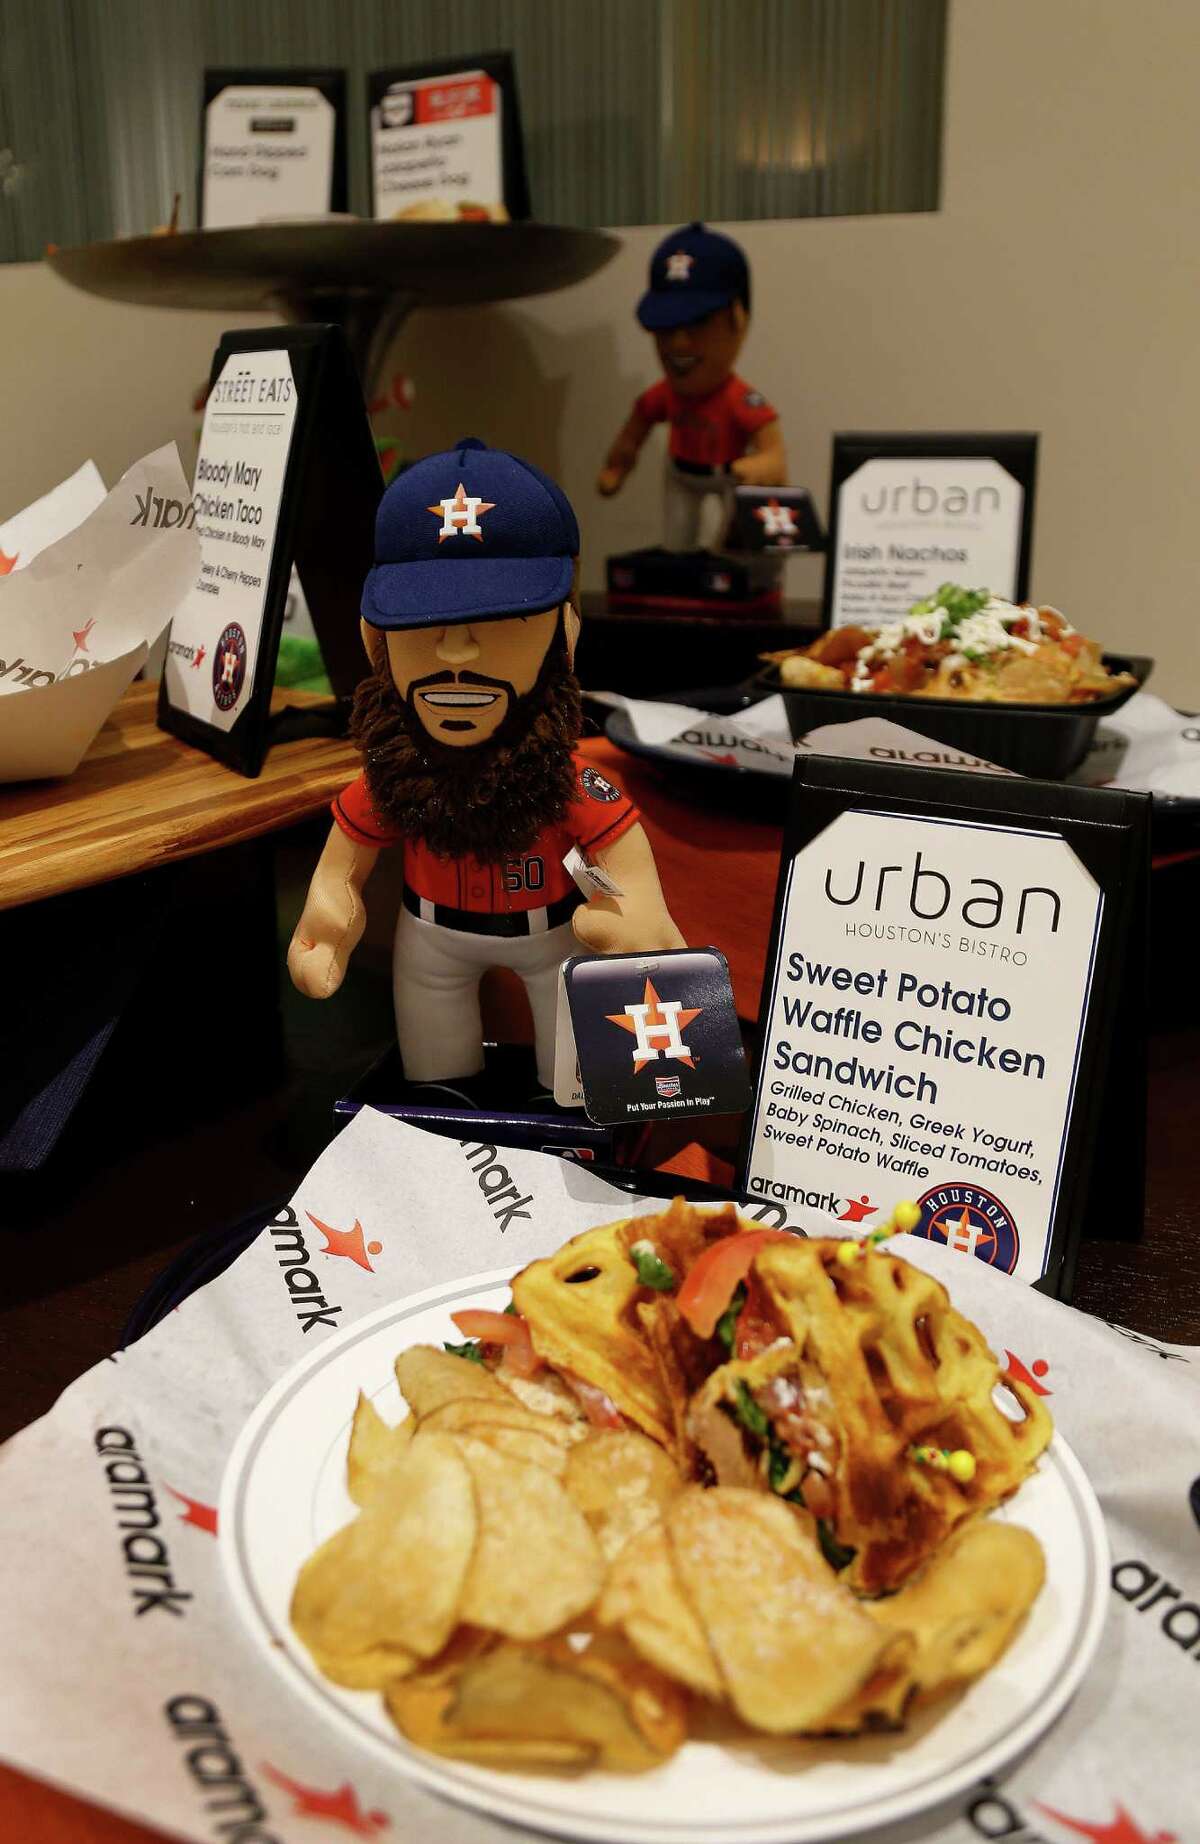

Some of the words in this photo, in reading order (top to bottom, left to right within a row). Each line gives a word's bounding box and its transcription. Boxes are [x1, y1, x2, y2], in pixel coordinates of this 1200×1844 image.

[258, 377, 293, 403] EATS
[198, 458, 232, 488] Bloody
[233, 460, 263, 492] Mary
[860, 476, 1001, 515] urban
[192, 493, 234, 521] Chicken
[236, 498, 263, 525] Taco
[824, 852, 1062, 934] urban
[845, 922, 952, 950] HOUSTON'S
[959, 936, 1028, 967] BISTRO
[786, 952, 889, 997] Sweet
[897, 973, 1012, 1022] Potato
[782, 995, 883, 1045] Waffle
[894, 1020, 1046, 1080] Chicken
[773, 1041, 938, 1105] Sandwich
[640, 1101, 656, 1111] Your
[657, 1098, 686, 1110] Passion
[770, 1081, 826, 1107] Grilled
[828, 1093, 903, 1127] Chicken,
[909, 1114, 966, 1140] Greek
[973, 1127, 1035, 1158] Yogurt,
[763, 1125, 813, 1150] Sweet
[816, 1137, 871, 1166] Potato
[876, 1152, 930, 1180] Waffle
[766, 1103, 809, 1128] Baby
[812, 1114, 885, 1147] Spinach,
[889, 1131, 946, 1160] Sliced
[949, 1146, 1044, 1186] Tomatoes,
[751, 1174, 841, 1215] aramark
[926, 1189, 1008, 1230] HOUSTON
[94, 1425, 193, 1618] aramark
